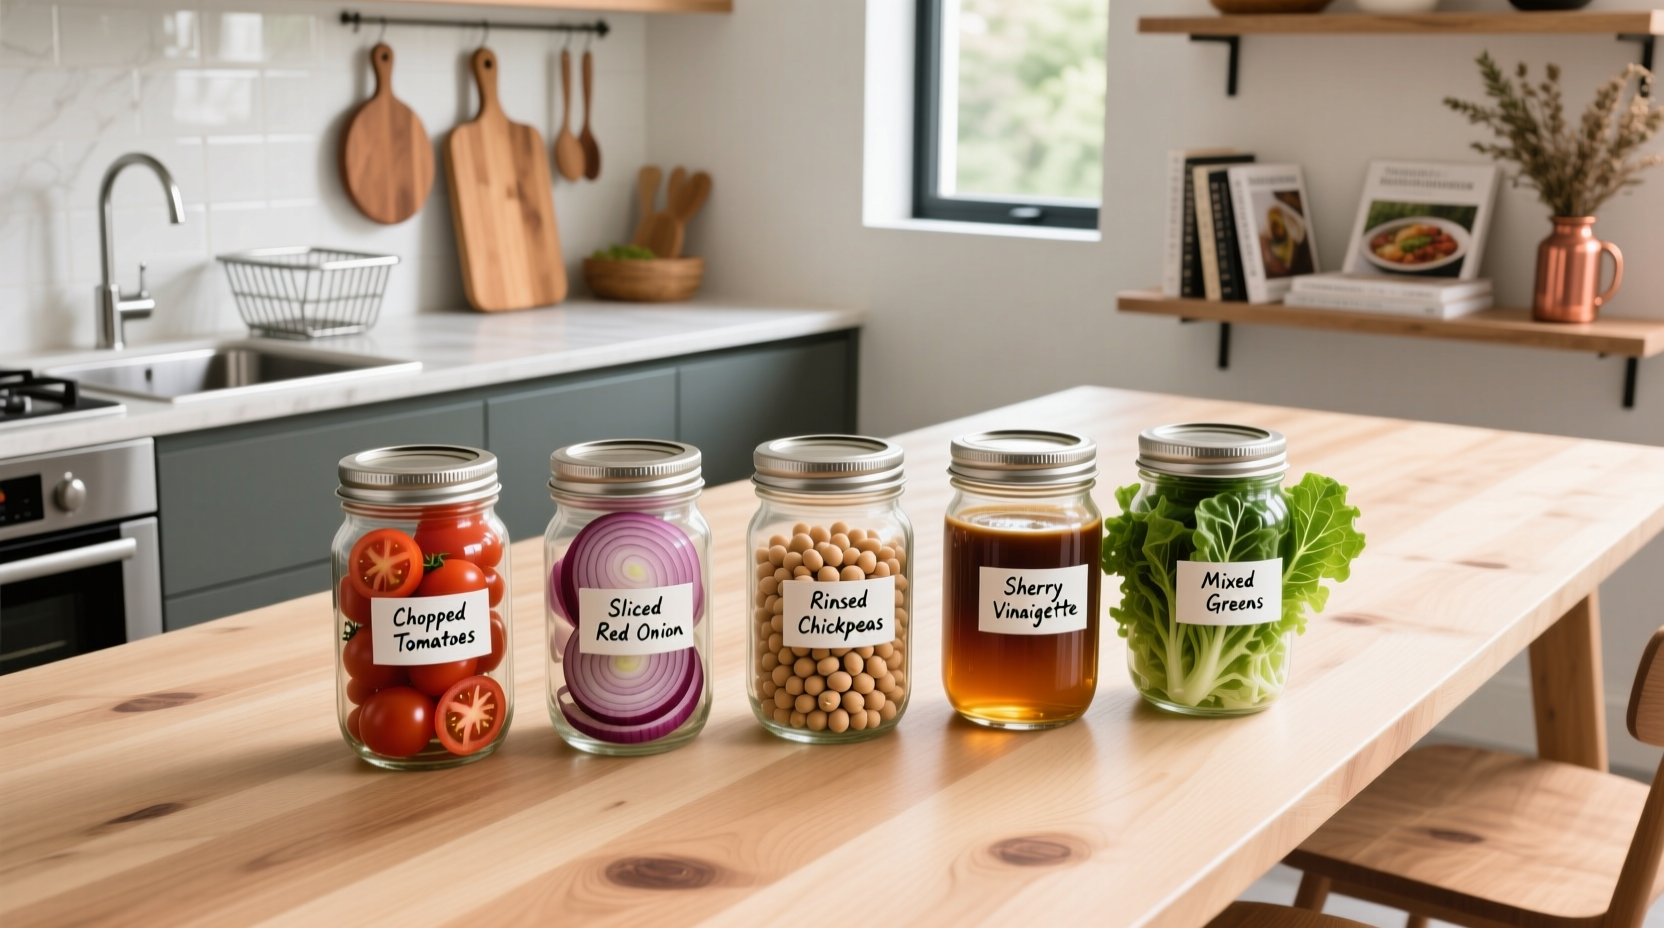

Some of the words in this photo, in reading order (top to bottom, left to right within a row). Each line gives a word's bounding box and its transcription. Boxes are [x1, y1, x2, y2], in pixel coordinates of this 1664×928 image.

[1003, 576, 1063, 603] Sherry
[1200, 569, 1255, 590] Mixed
[608, 595, 663, 618] Sliced
[810, 588, 868, 610] Rinsed
[1206, 593, 1264, 615] Greens
[393, 601, 467, 633] Chopped
[993, 598, 1078, 628] Vinaigette
[595, 622, 630, 642] Red
[636, 622, 684, 642] Onion
[798, 615, 883, 642] Chickpeas
[393, 630, 475, 653] Tomatoes
